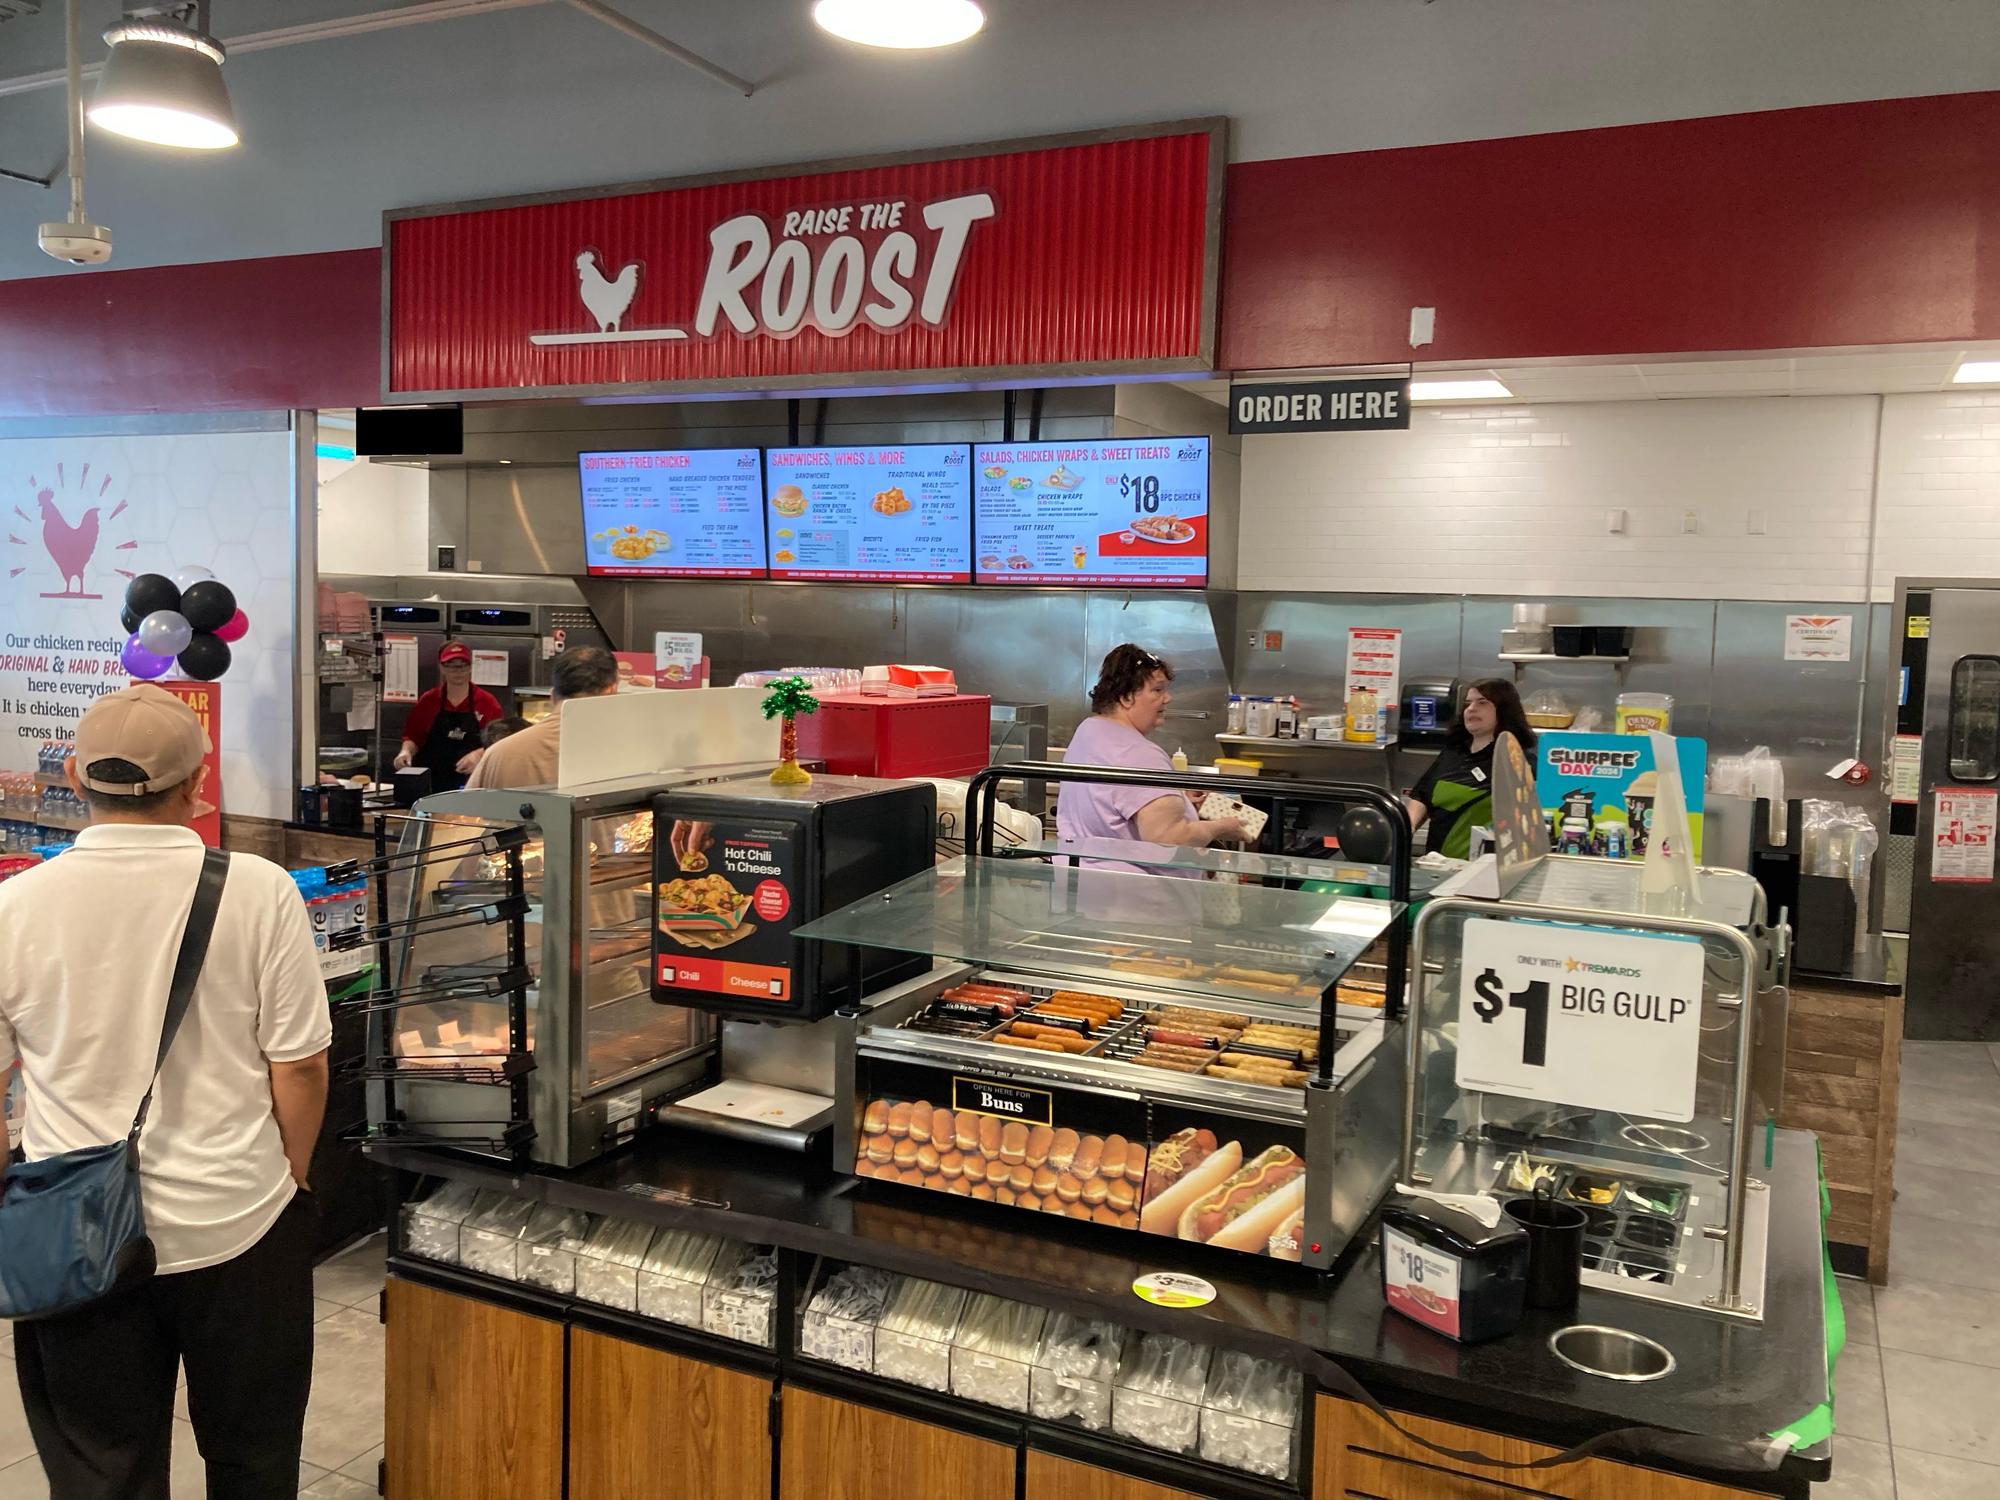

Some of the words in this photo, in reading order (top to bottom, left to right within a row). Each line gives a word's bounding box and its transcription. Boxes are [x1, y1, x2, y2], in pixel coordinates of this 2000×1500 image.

[783, 206, 853, 237] RAISE
[859, 201, 906, 231] THE
[695, 193, 996, 338] ROOST
[1238, 394, 1323, 423] ORDER
[1331, 391, 1399, 420] HERE
[655, 455, 690, 469] CHICKEN
[772, 453, 832, 467] SANDWICHES,
[835, 452, 865, 466] WINGS
[879, 451, 905, 465] MORE
[980, 451, 1014, 465] SALADS,
[1016, 450, 1054, 463] CHICKEN
[1056, 449, 1088, 462] WRAPS
[1091, 449, 1099, 461] &
[1101, 448, 1132, 461] SWEET
[1135, 447, 1170, 460] TREATS
[795, 472, 830, 480] SANDWICHES
[888, 471, 925, 479] TRADITIONAL
[927, 470, 947, 479] WINGS
[1120, 473, 1160, 514] $18
[1173, 492, 1201, 502] CHICKEN
[6, 633, 30, 648] Our
[34, 634, 84, 651] chicken
[88, 637, 123, 656] recip
[0, 654, 49, 672] ORIGINAL
[53, 656, 64, 673] &
[69, 659, 99, 674] HAND
[28, 677, 57, 693] here
[3, 699, 11, 713] It
[16, 699, 26, 714] is
[30, 701, 80, 718] chicken
[18, 726, 51, 739] cross
[56, 726, 75, 740] the
[1550, 749, 1635, 768] SLURPEE
[1560, 763, 1594, 777] DAY
[725, 848, 746, 860] Hot
[748, 850, 772, 862] Chili
[725, 861, 735, 872] 'n
[737, 861, 782, 876] Cheese
[1517, 954, 1538, 967] ONLY
[1540, 957, 1562, 969] WITH
[679, 969, 700, 981] Chili
[730, 976, 768, 990] Cheese
[1472, 968, 1551, 1067] $1
[1561, 984, 1605, 1014] BIG
[973, 1083, 993, 1093] OPEN
[994, 1086, 1014, 1096] HERE
[1015, 1089, 1031, 1099] FOR
[980, 1091, 1024, 1113] Buns
[1400, 1247, 1424, 1284] $18
